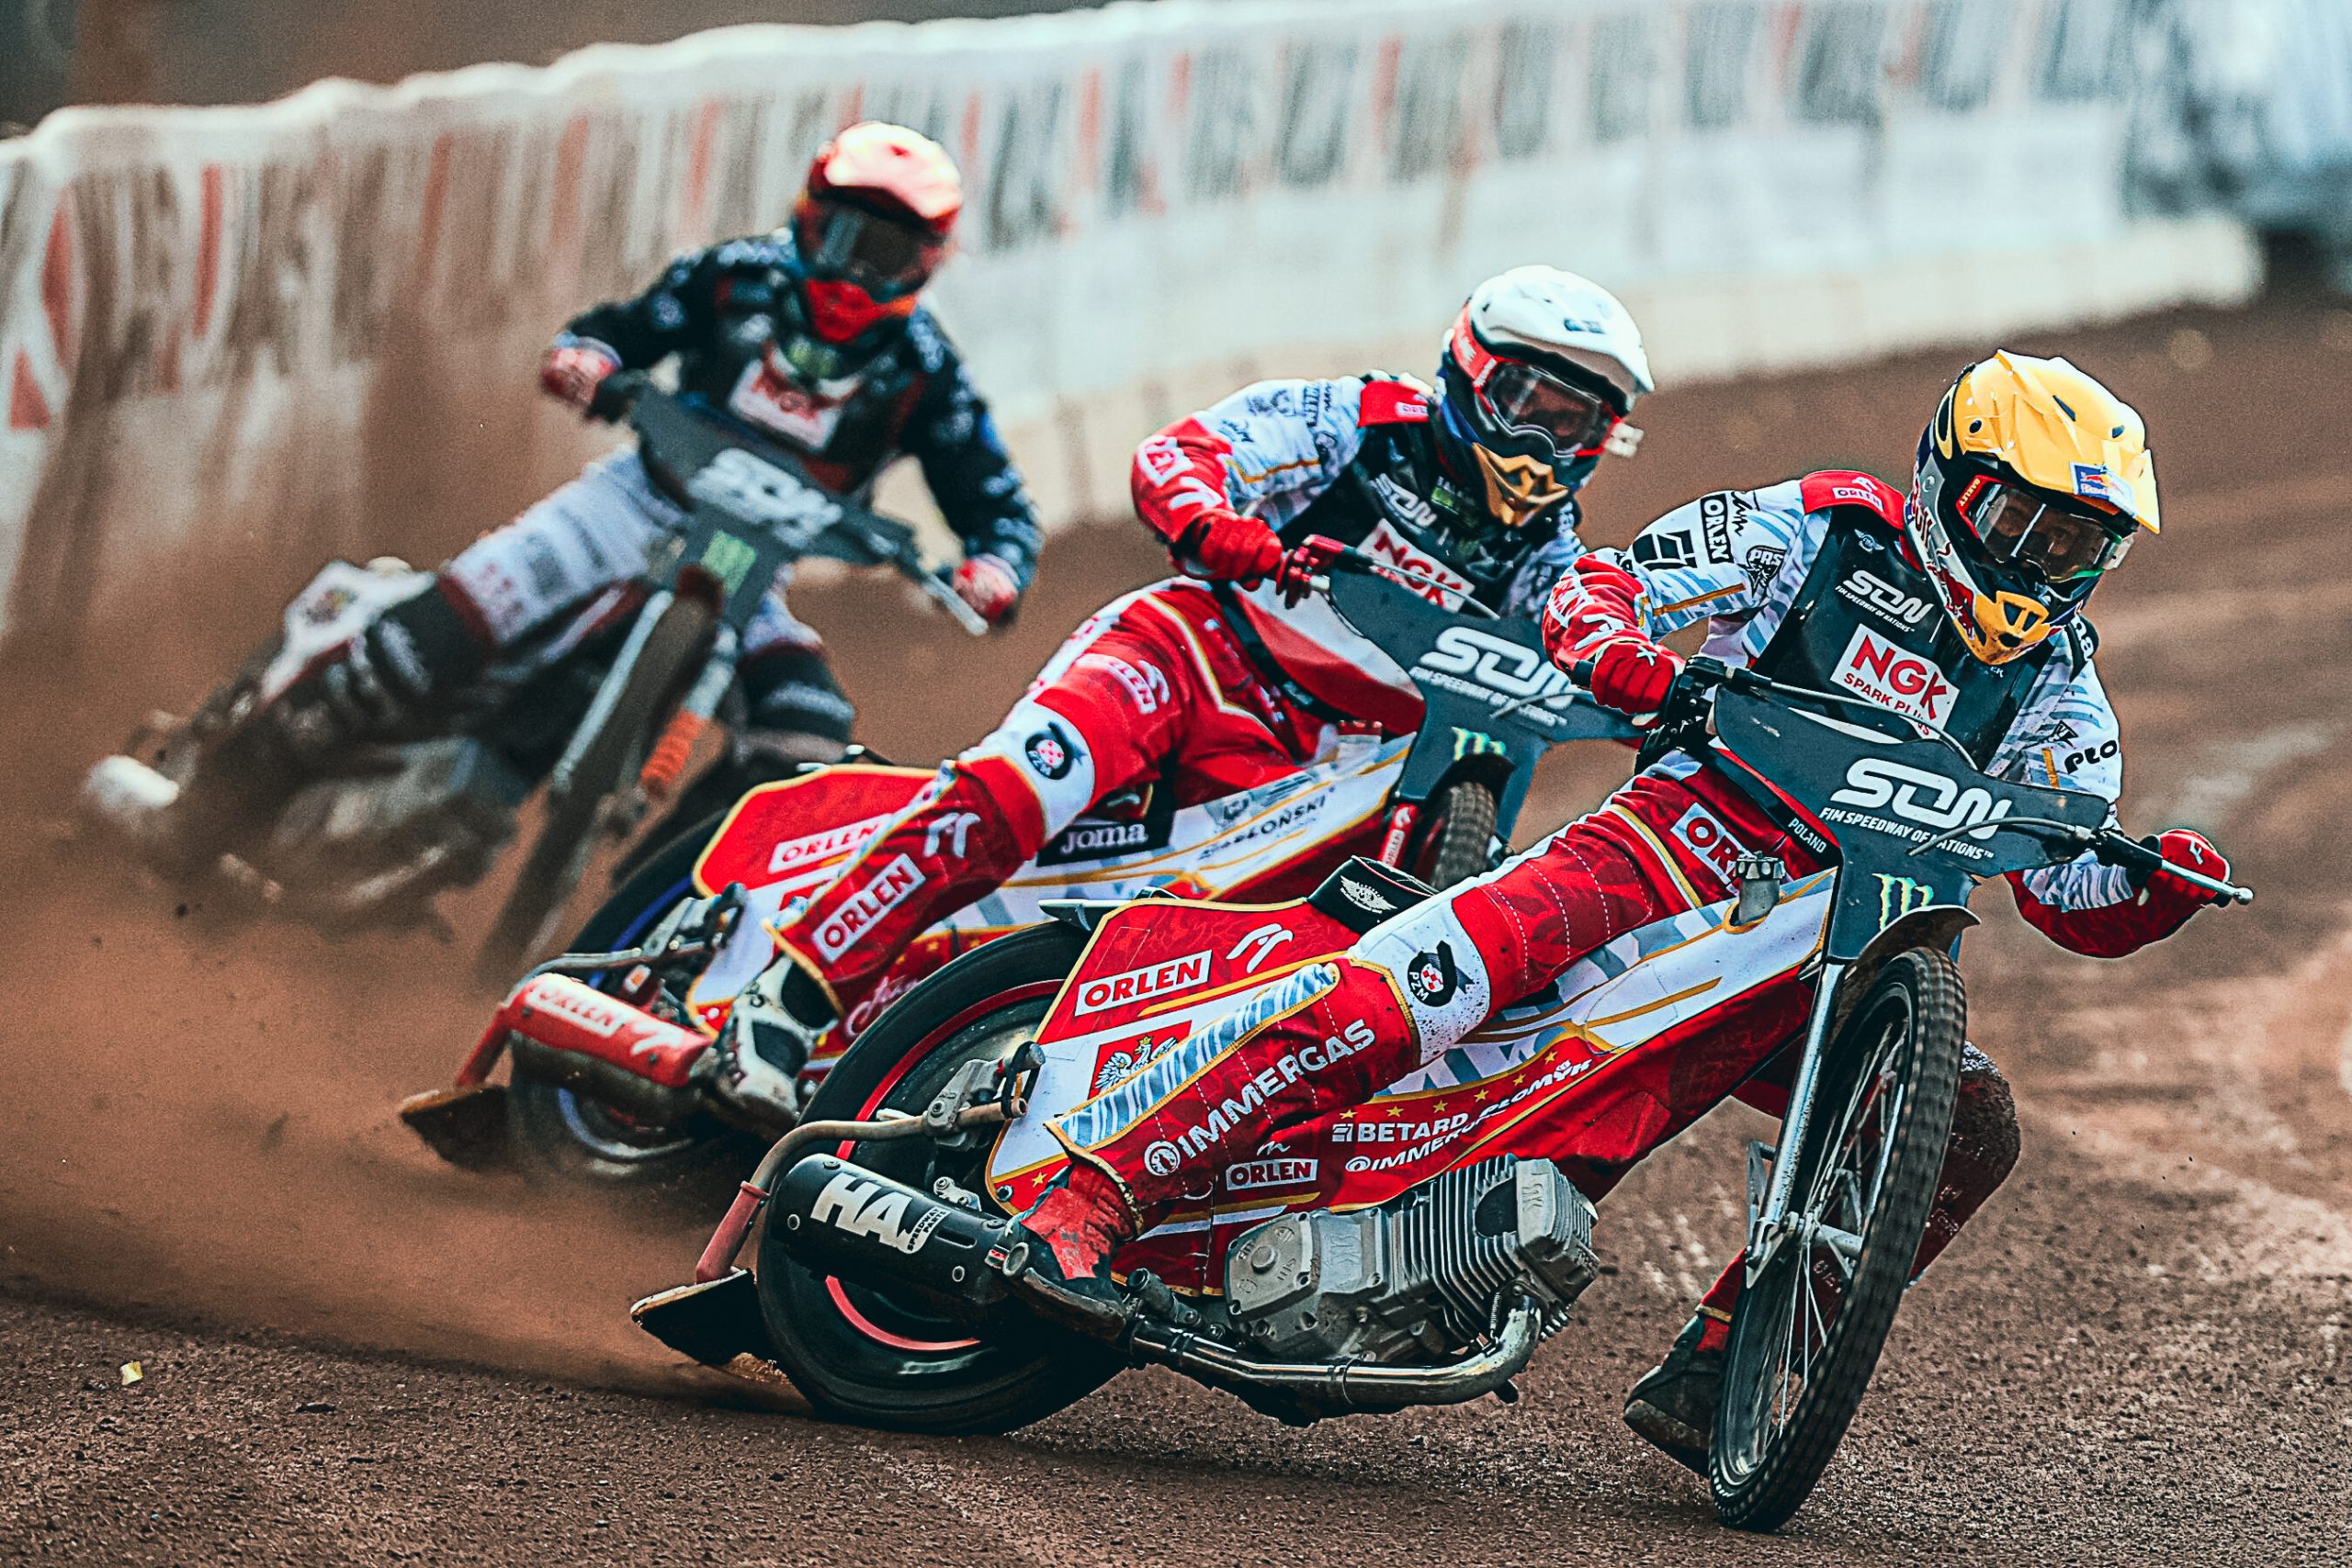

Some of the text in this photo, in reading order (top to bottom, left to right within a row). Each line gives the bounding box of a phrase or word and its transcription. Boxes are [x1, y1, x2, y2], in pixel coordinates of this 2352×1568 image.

[1959, 478, 1981, 507] OAKLEY
[1703, 499, 1729, 559] ORLEN
[1747, 548, 1784, 566] PRS
[1835, 585, 1849, 596] FIM
[1845, 592, 1878, 613] SPEEDWAY
[1874, 609, 1885, 617] OF
[1843, 672, 1892, 707] SPARK
[1850, 634, 1947, 721] NGK
[1788, 818, 1827, 853] POLAND
[1819, 807, 1844, 823] FIM
[1843, 812, 1913, 839] SPEEDWAY
[1910, 829, 1930, 843] OF
[782, 823, 879, 863] ORLEN
[823, 864, 915, 949] ORLEN
[1084, 957, 1203, 1008] ORLEN
[1408, 971, 1430, 1002] PZM
[1177, 1019, 1375, 1159] IMMERGAS
[1358, 1112, 1469, 1143] BETARD
[1229, 1160, 1313, 1186] ORLEN
[907, 1208, 939, 1252] SPEEDWAY
